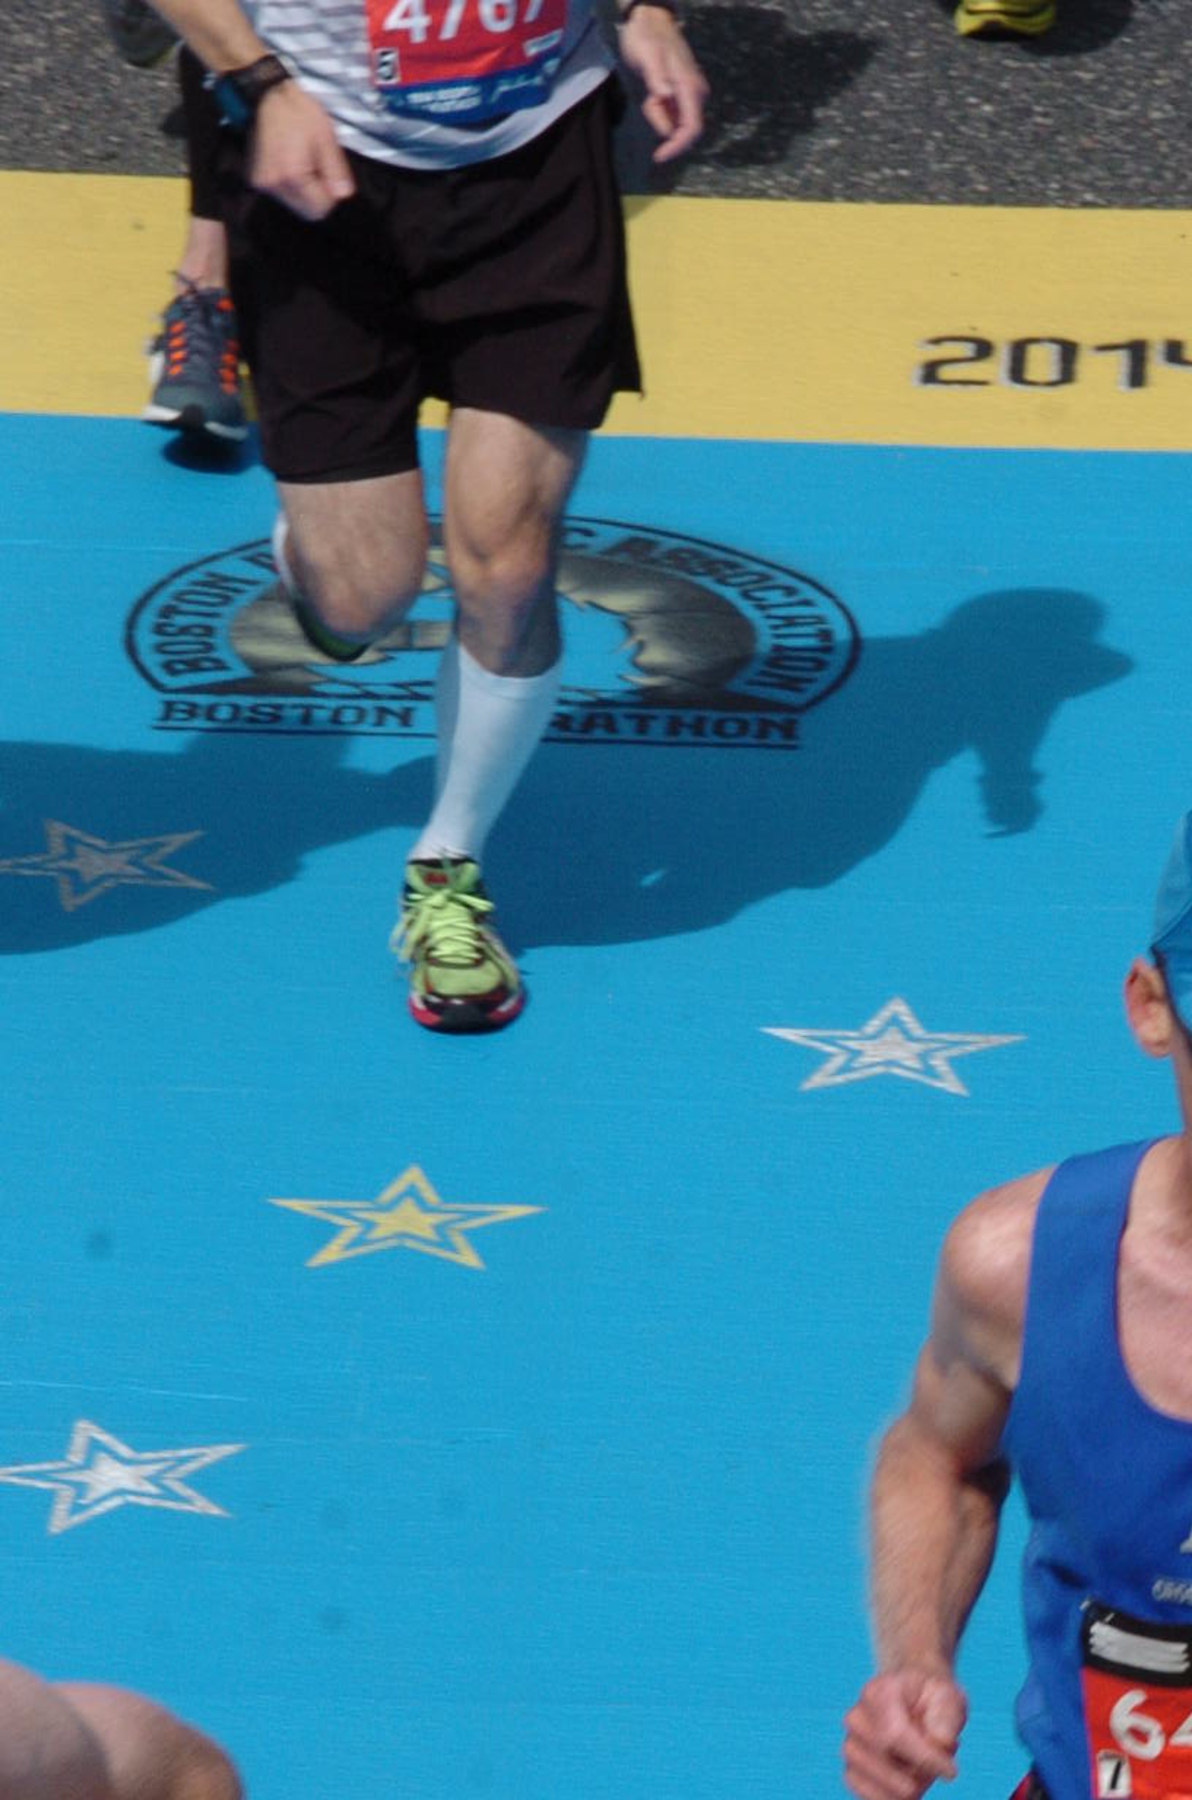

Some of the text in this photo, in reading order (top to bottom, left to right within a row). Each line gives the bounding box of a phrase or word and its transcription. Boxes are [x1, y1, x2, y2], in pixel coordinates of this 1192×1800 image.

[153, 571, 262, 677] BOSTON
[157, 700, 799, 740] BOSTON RATHON
